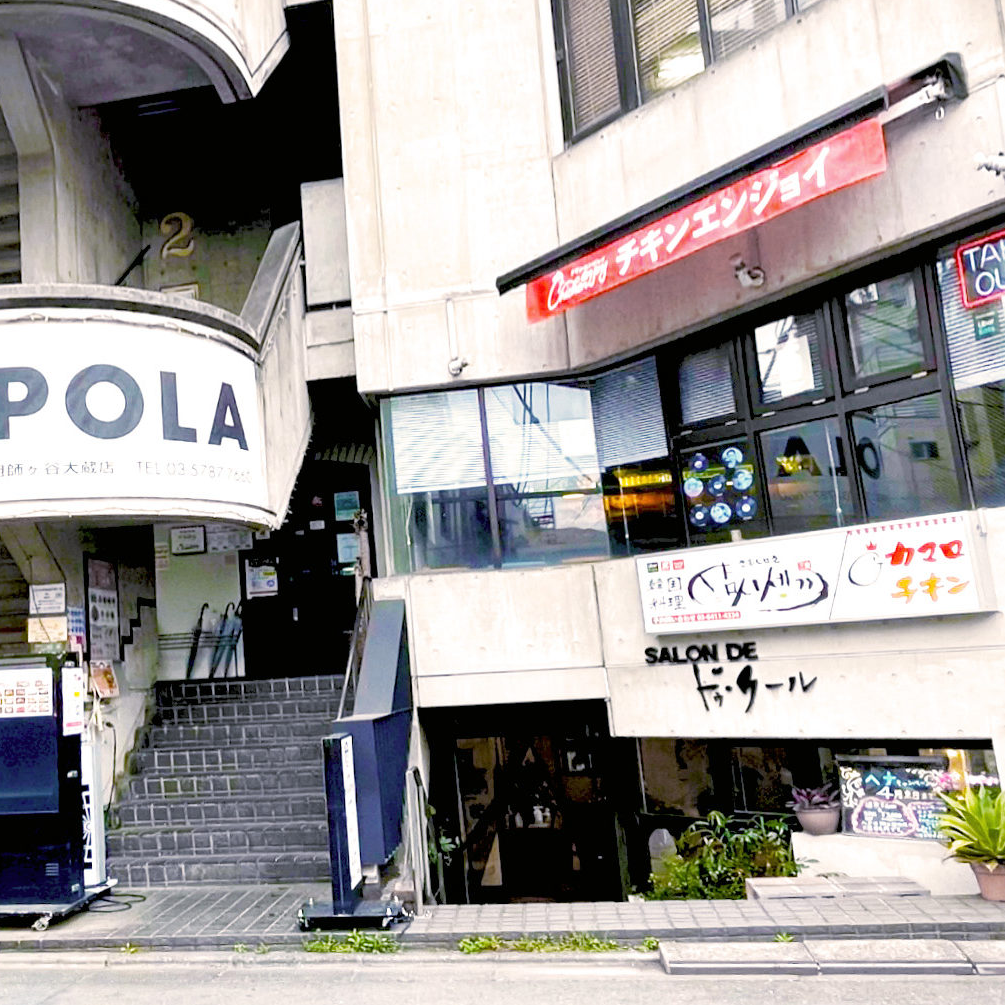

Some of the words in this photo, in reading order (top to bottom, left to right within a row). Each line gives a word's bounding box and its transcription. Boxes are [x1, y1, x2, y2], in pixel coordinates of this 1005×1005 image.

[614, 147, 831, 276] チキンエンジョイ
[160, 212, 194, 259] 2
[891, 573, 970, 604] チキン
[645, 644, 719, 664] SALON
[726, 642, 758, 660] DE
